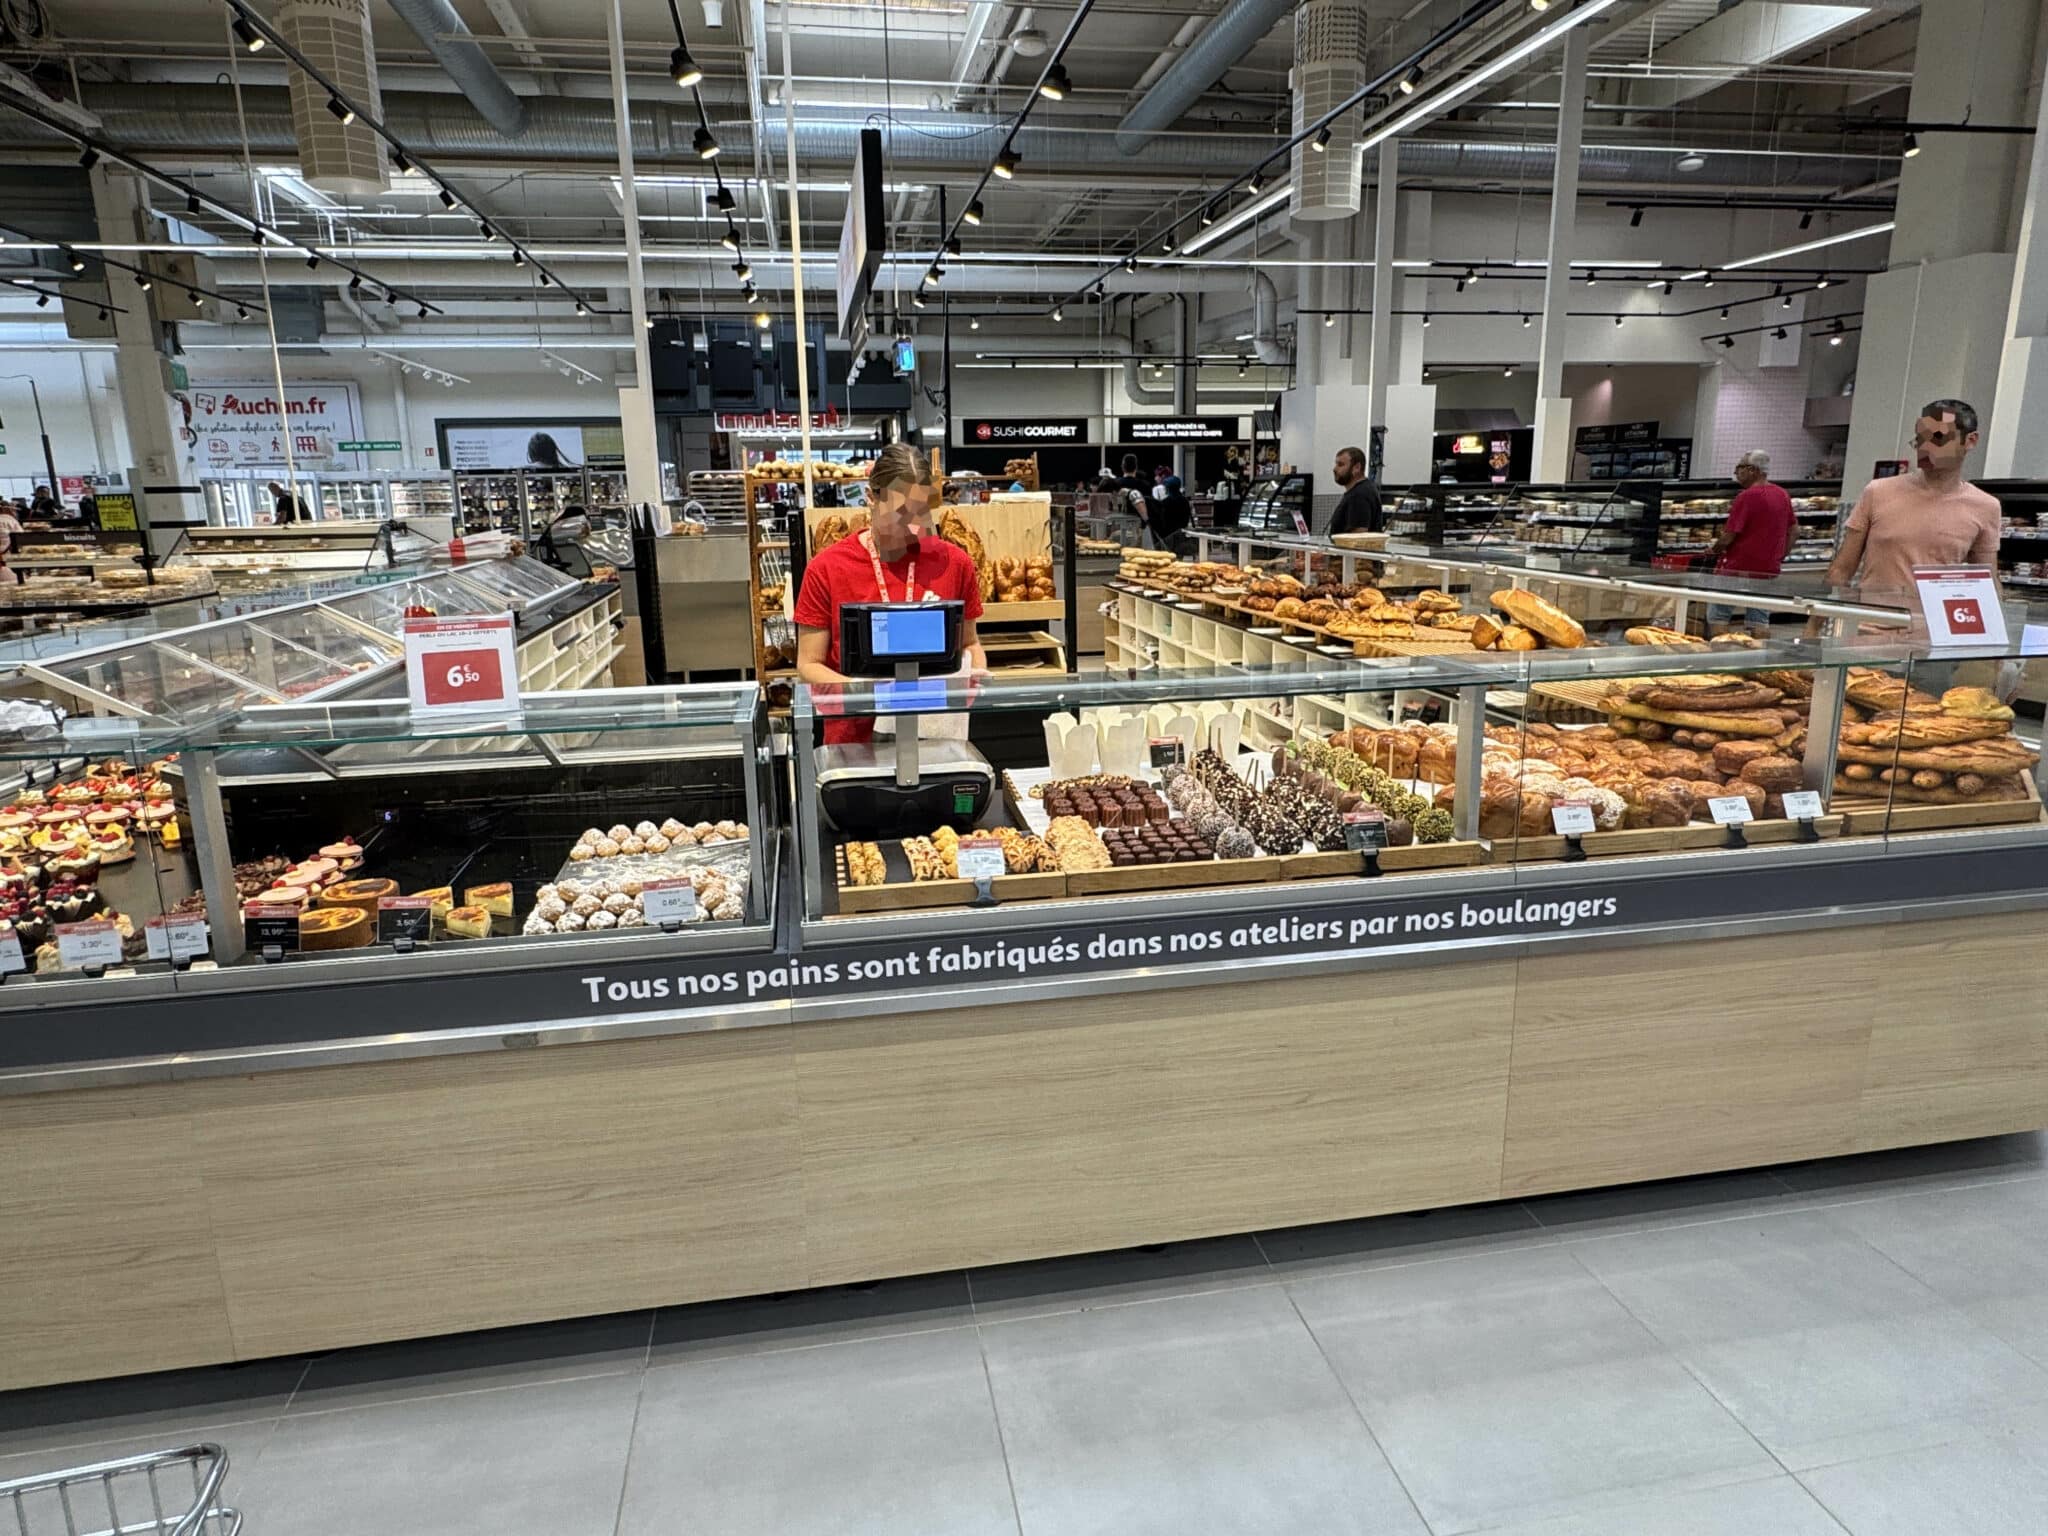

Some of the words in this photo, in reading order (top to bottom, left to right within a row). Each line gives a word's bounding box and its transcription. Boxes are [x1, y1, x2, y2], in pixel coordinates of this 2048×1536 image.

[581, 976, 670, 1003] Tous
[678, 972, 739, 995] nos
[747, 958, 840, 996] pains
[847, 951, 921, 982] sont
[926, 937, 1081, 973] fabriqués
[1087, 933, 1163, 960] dans
[1170, 931, 1223, 952] nos
[1229, 916, 1343, 946] ateliers
[1350, 915, 1399, 944] par
[1405, 911, 1455, 932] nos
[1461, 897, 1617, 930] boulangers
